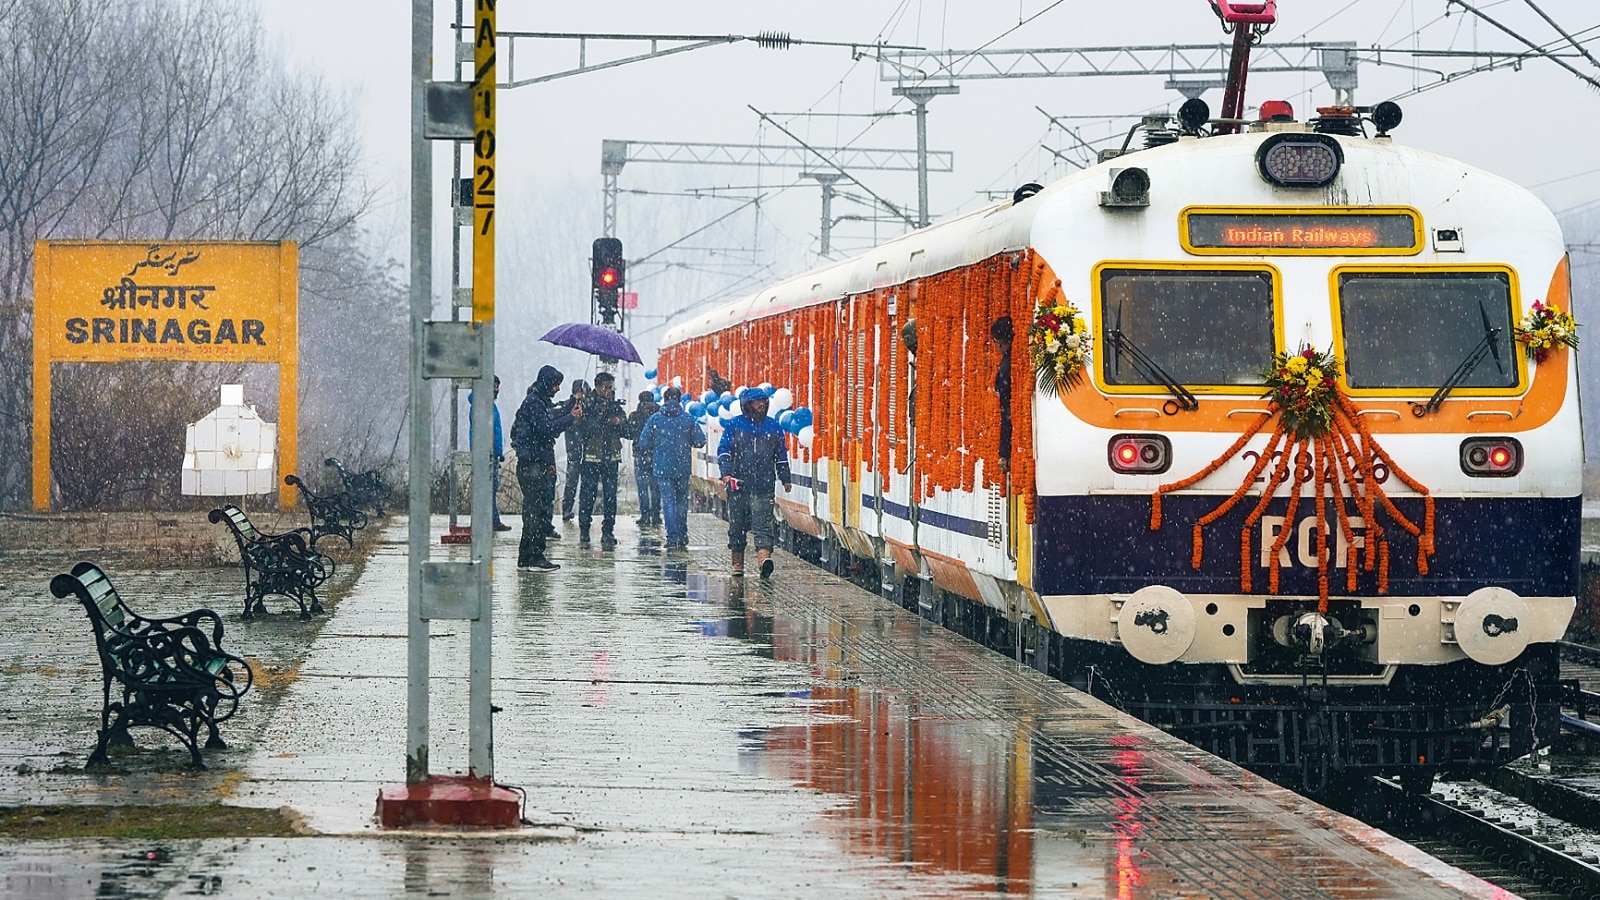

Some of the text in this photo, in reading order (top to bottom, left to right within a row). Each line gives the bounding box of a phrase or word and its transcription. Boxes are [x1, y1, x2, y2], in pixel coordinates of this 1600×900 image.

[1227, 228, 1372, 245] Indian Railways
[100, 277, 216, 310] श्रीनगर
[65, 317, 266, 346] SRINAGAR
[1260, 515, 1366, 568] RCF
